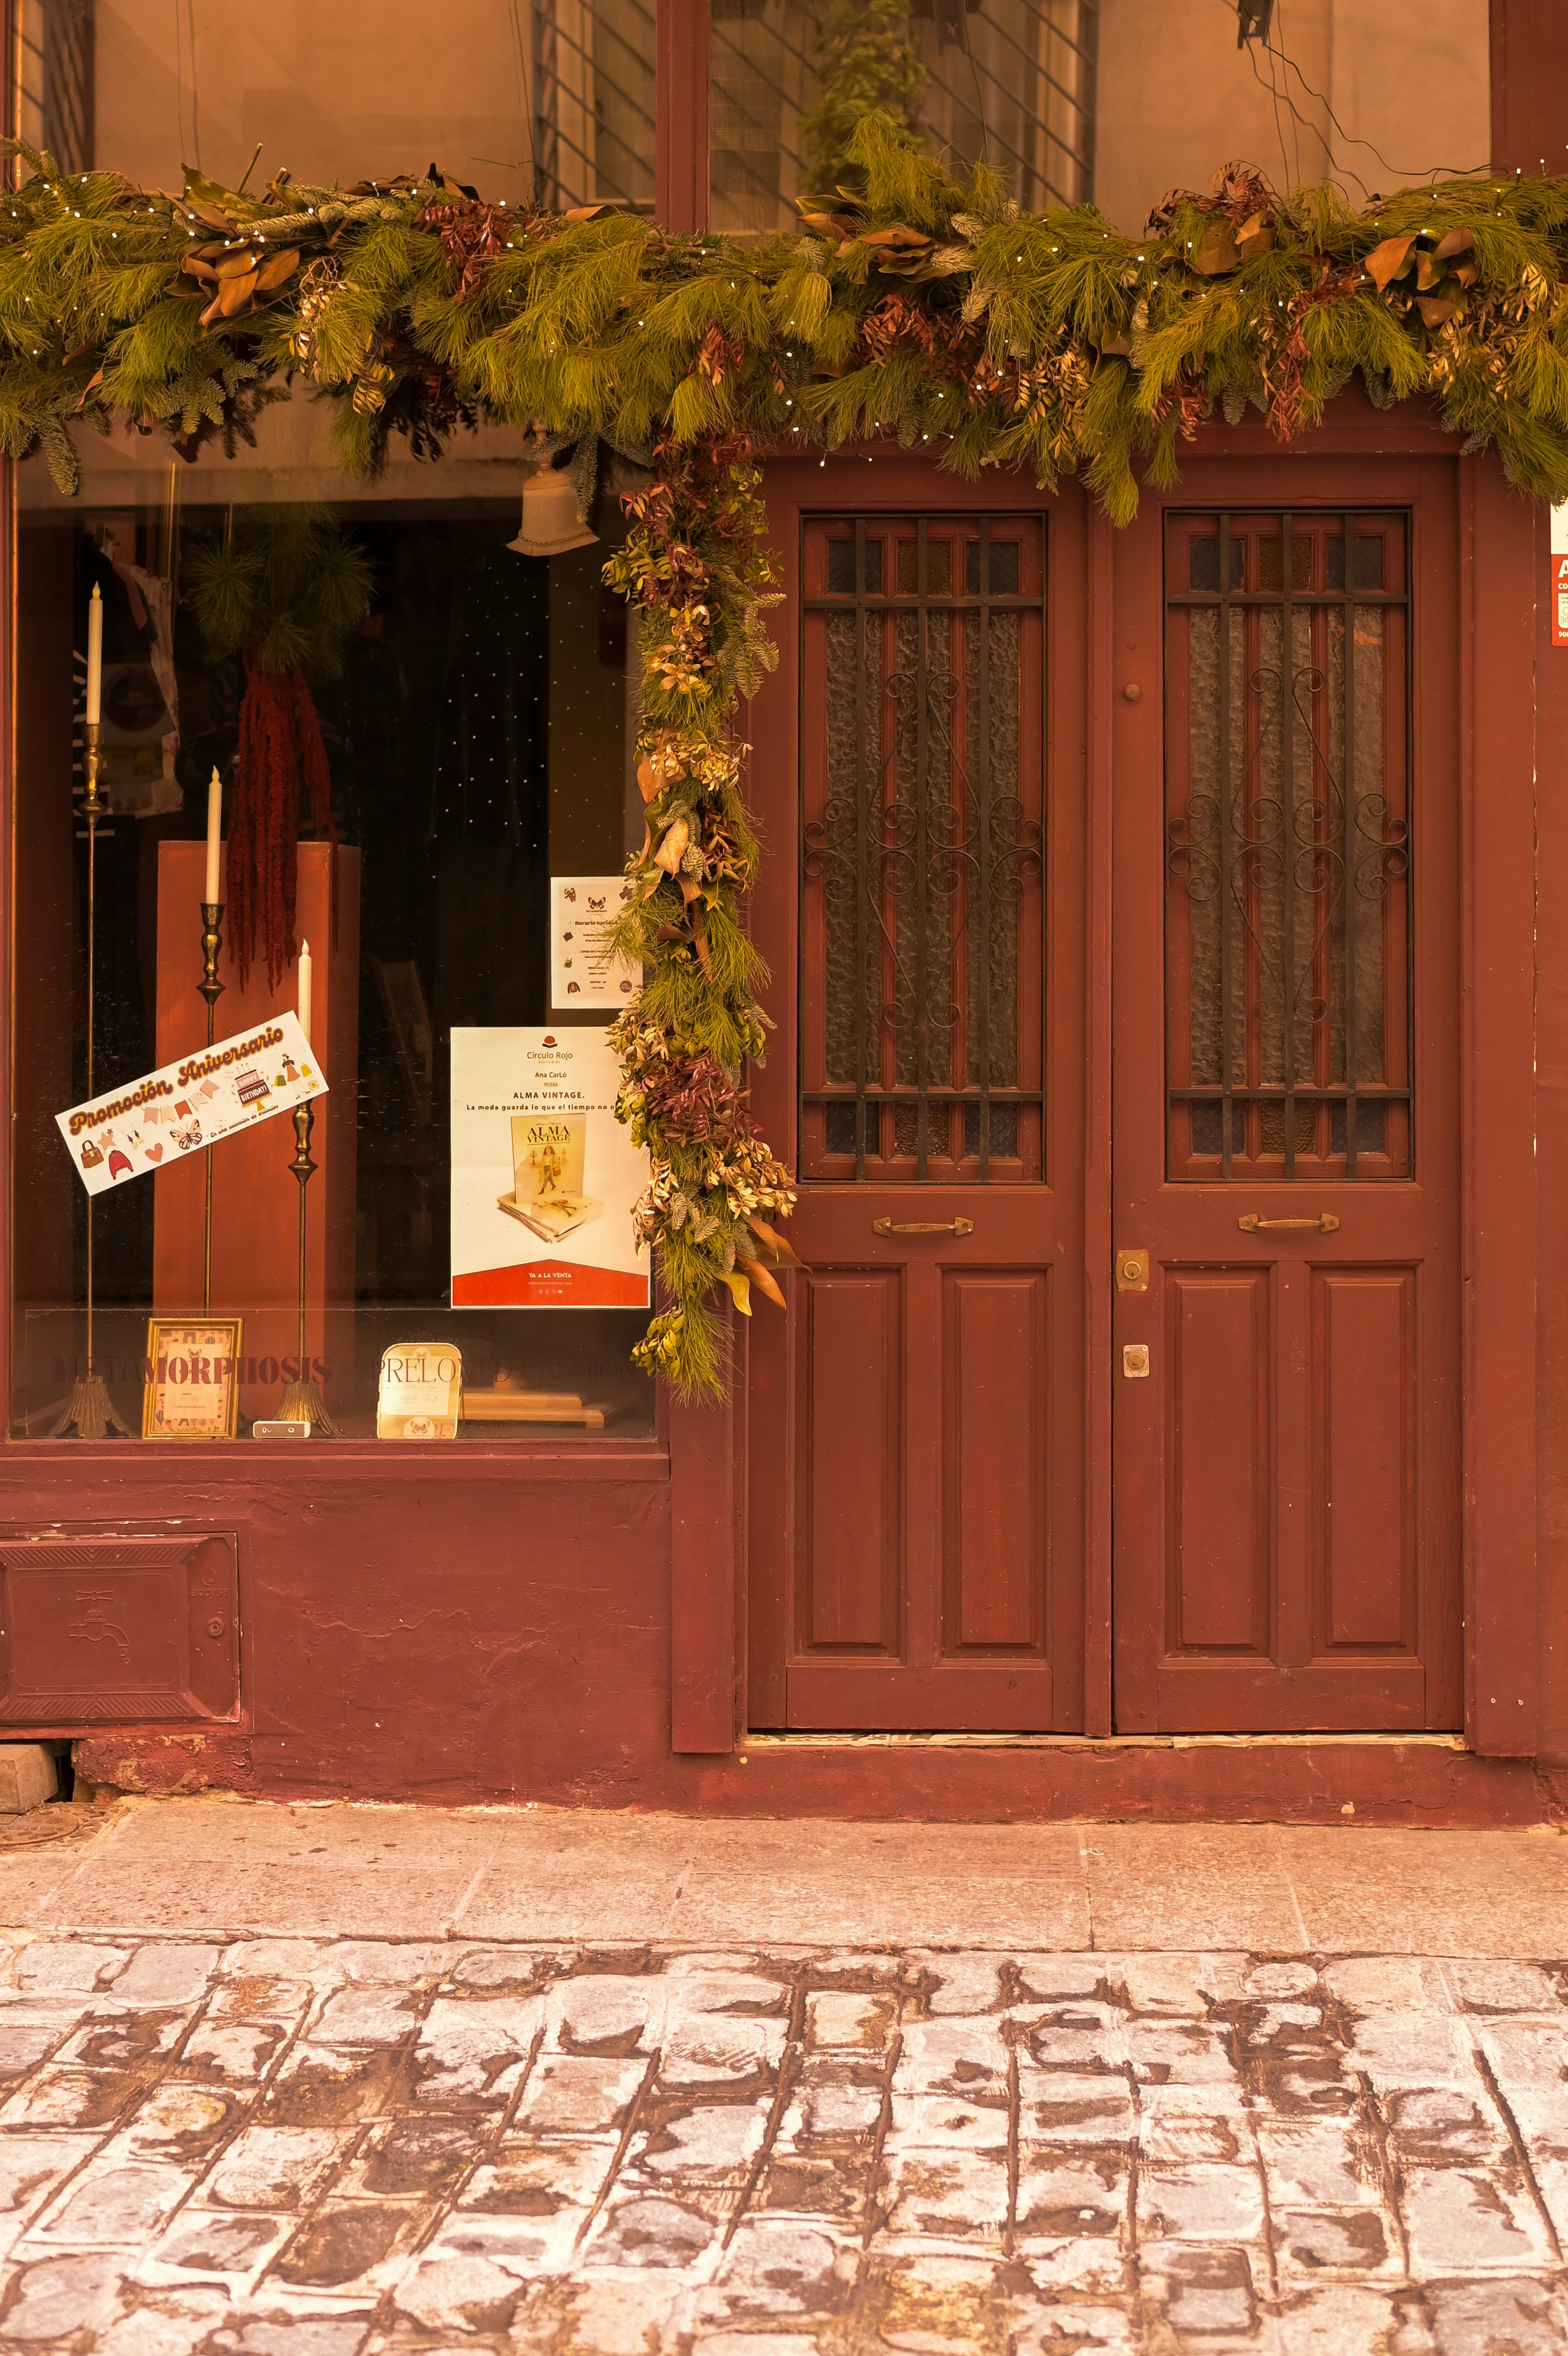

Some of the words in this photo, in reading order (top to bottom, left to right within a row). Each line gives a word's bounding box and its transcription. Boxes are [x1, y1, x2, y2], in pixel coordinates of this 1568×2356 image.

[556, 1052, 573, 1060] Rojo
[68, 1080, 174, 1136] Promoción
[177, 1026, 284, 1088] Aniversario
[239, 1074, 257, 1087] HAPPY
[240, 1084, 268, 1102] BIRTHDAY!
[527, 1126, 570, 1136] ALMA
[527, 1134, 571, 1143] VINTAGE
[52, 1356, 332, 1384] METAMORPHOSIS
[372, 1357, 512, 1383] PRELOVED
